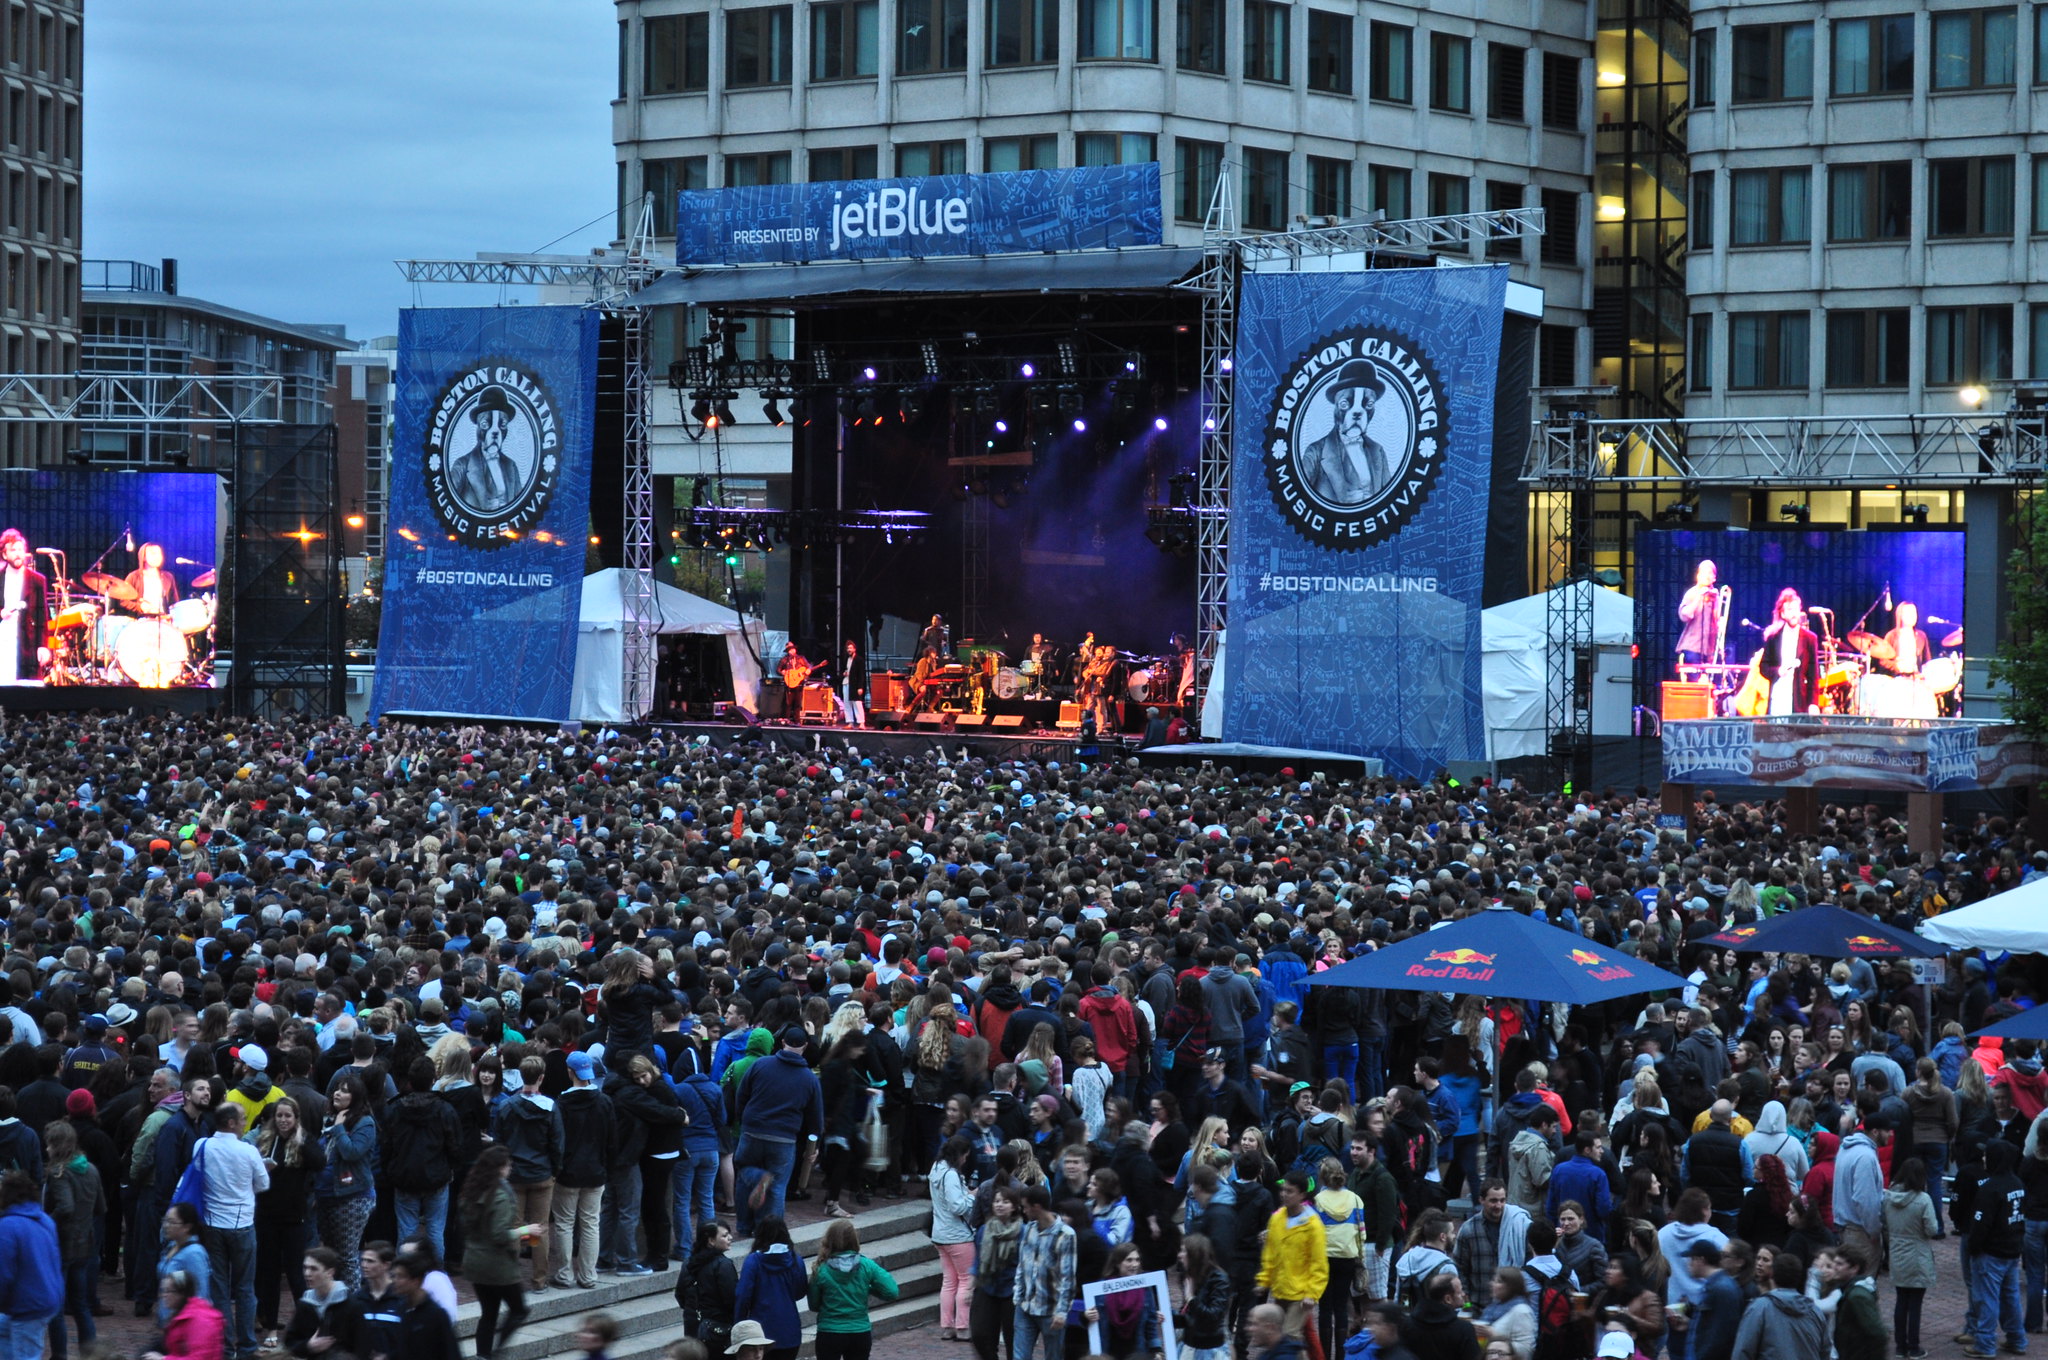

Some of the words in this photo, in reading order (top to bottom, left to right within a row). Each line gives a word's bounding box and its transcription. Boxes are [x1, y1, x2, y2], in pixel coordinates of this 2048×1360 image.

[733, 228, 802, 244] PRESENTED
[804, 227, 820, 241] BY
[829, 187, 968, 251] jetBlue
[1275, 338, 1356, 431] BOSTON
[1361, 337, 1439, 431] CALLING
[429, 366, 490, 447] BOSTON
[494, 365, 558, 450] CALLING
[432, 476, 468, 535] MUSIC
[475, 476, 552, 539] FESTIVAL
[1275, 466, 1324, 532] MUSIC
[1334, 462, 1430, 538] FESTIVAL
[416, 568, 553, 587] #BOSTONCALLING
[1259, 572, 1437, 592] #BOSTONCALLING
[1661, 722, 1764, 755] SAMUEL
[1926, 727, 1979, 763] SAMUEL
[1667, 747, 1754, 781] ADAMS
[1757, 757, 1799, 773] CHEERS
[1803, 750, 1825, 767] 30
[1932, 752, 1979, 790] ADAMS
[1405, 964, 1451, 979] Red
[1449, 967, 1496, 981] Bull
[73, 1061, 101, 1072] SHIELDS
